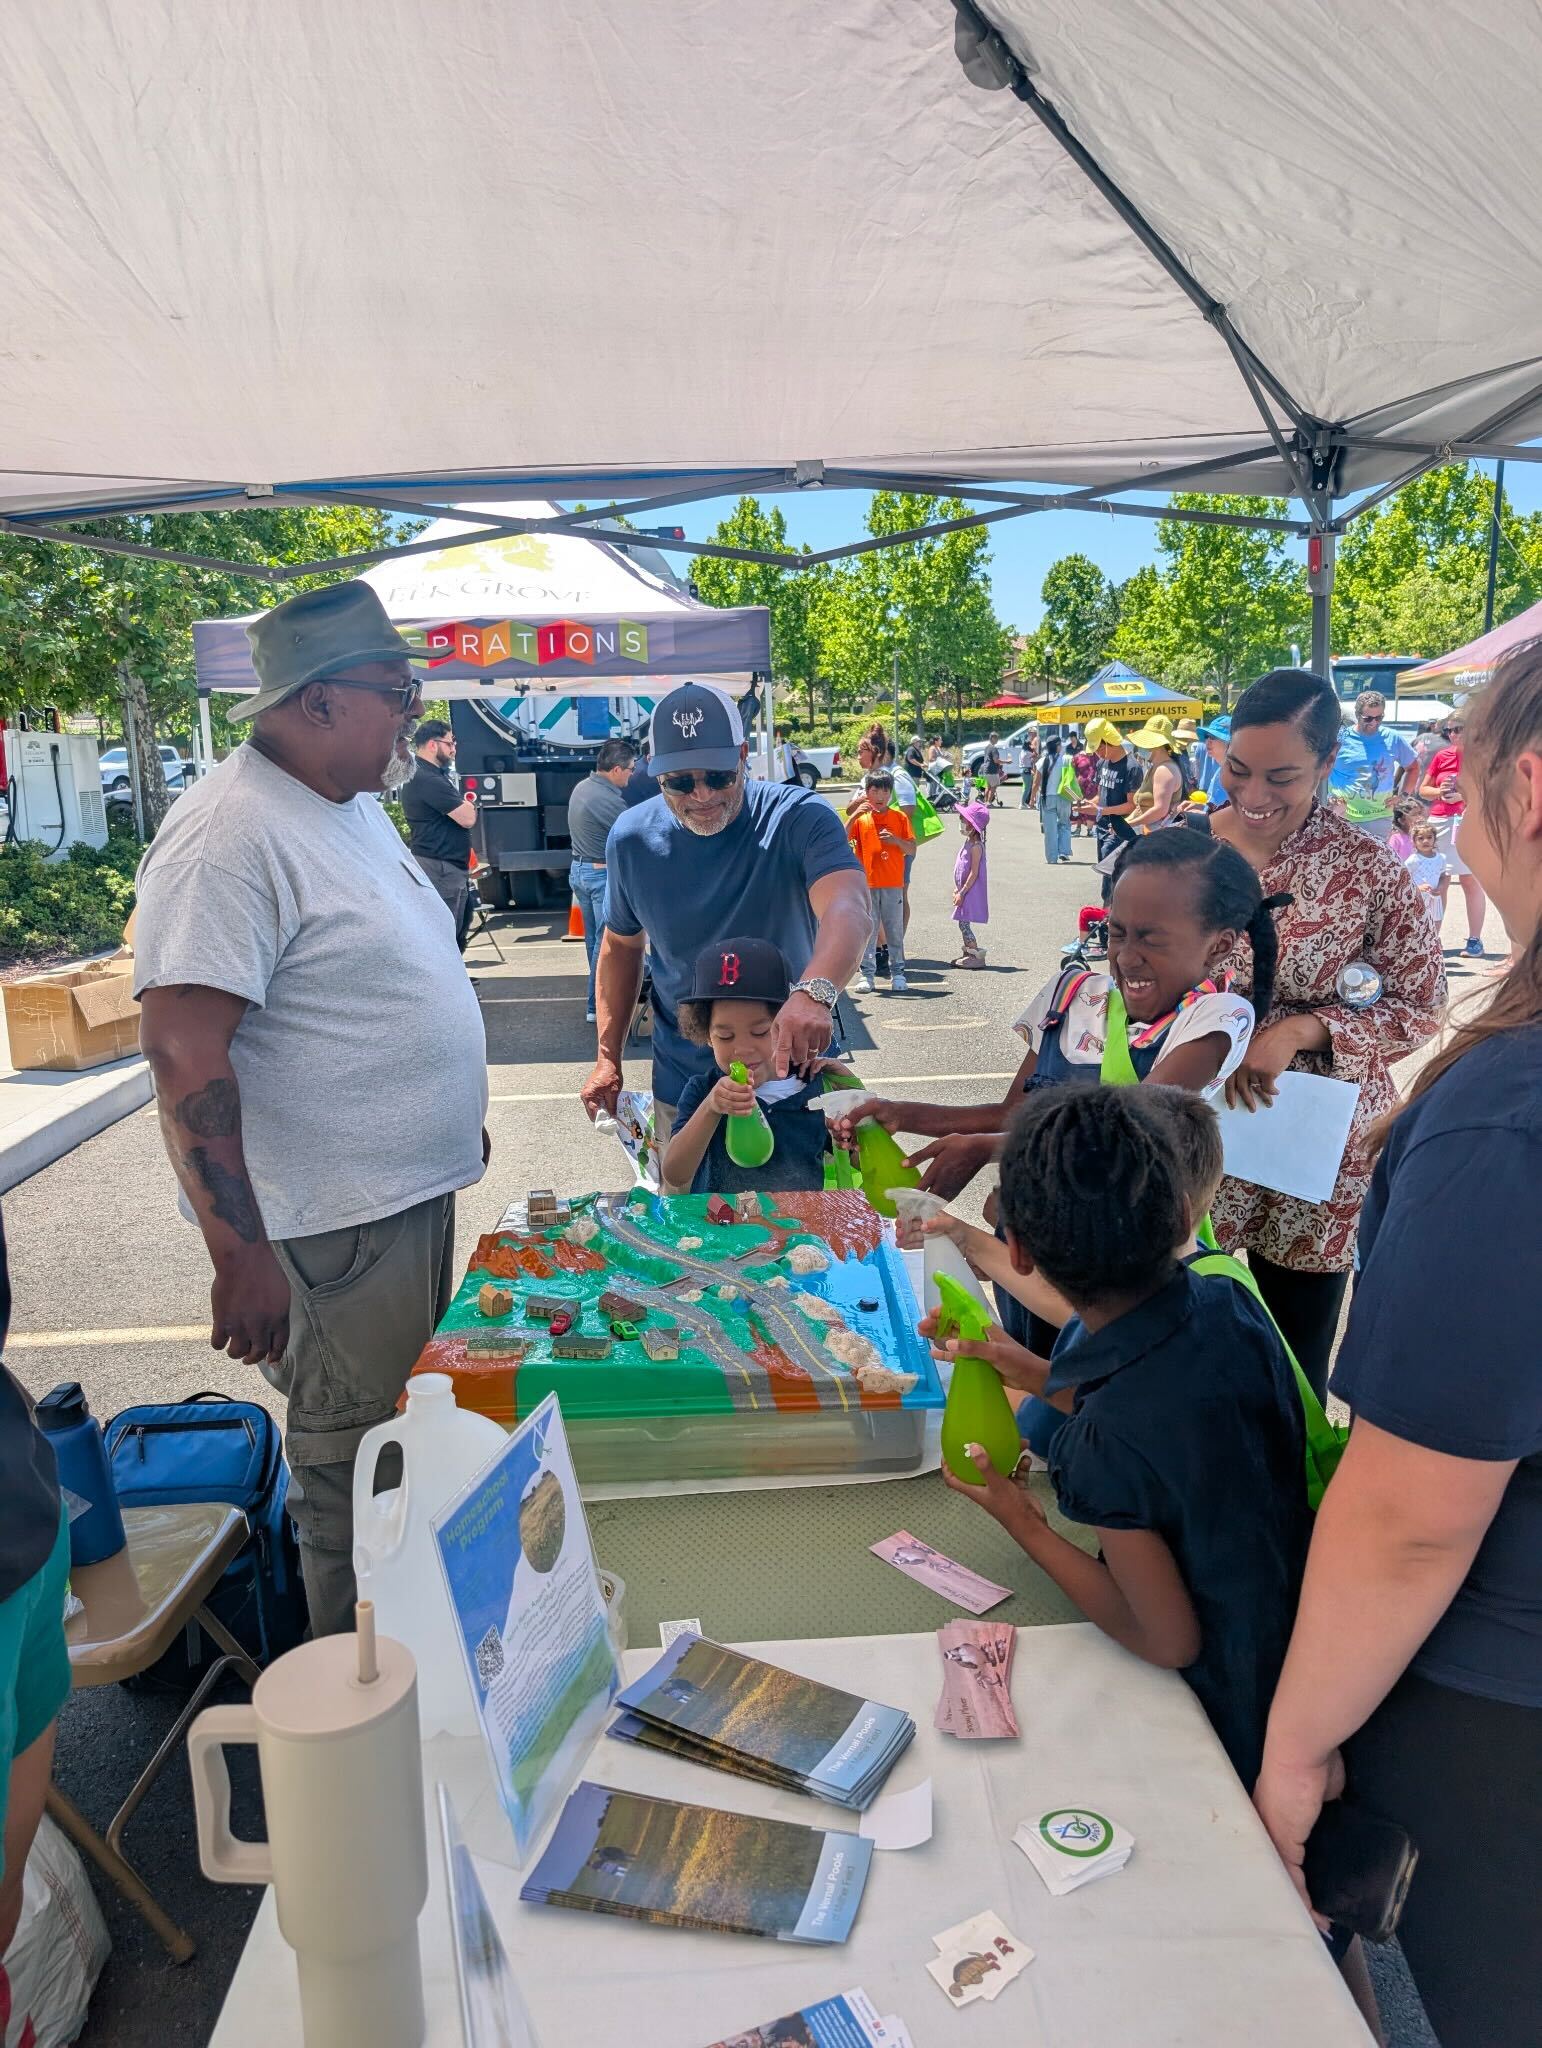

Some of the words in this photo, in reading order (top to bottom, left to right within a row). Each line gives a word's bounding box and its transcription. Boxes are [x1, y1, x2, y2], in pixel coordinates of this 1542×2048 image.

[460, 578, 590, 602] GROVE
[1076, 707, 1126, 719] PAVEMENT
[1128, 706, 1188, 716] SPECIALISTS
[682, 725, 697, 738] CA
[719, 952, 740, 985] B
[446, 1469, 509, 1544] Homeschool
[461, 1498, 504, 1552] Program
[827, 1761, 844, 1773] The
[839, 1737, 861, 1760] Vernal
[857, 1717, 876, 1740] Pools
[828, 1852, 845, 1881] Pools
[818, 1882, 835, 1910] Vernal
[811, 1911, 827, 1926] The
